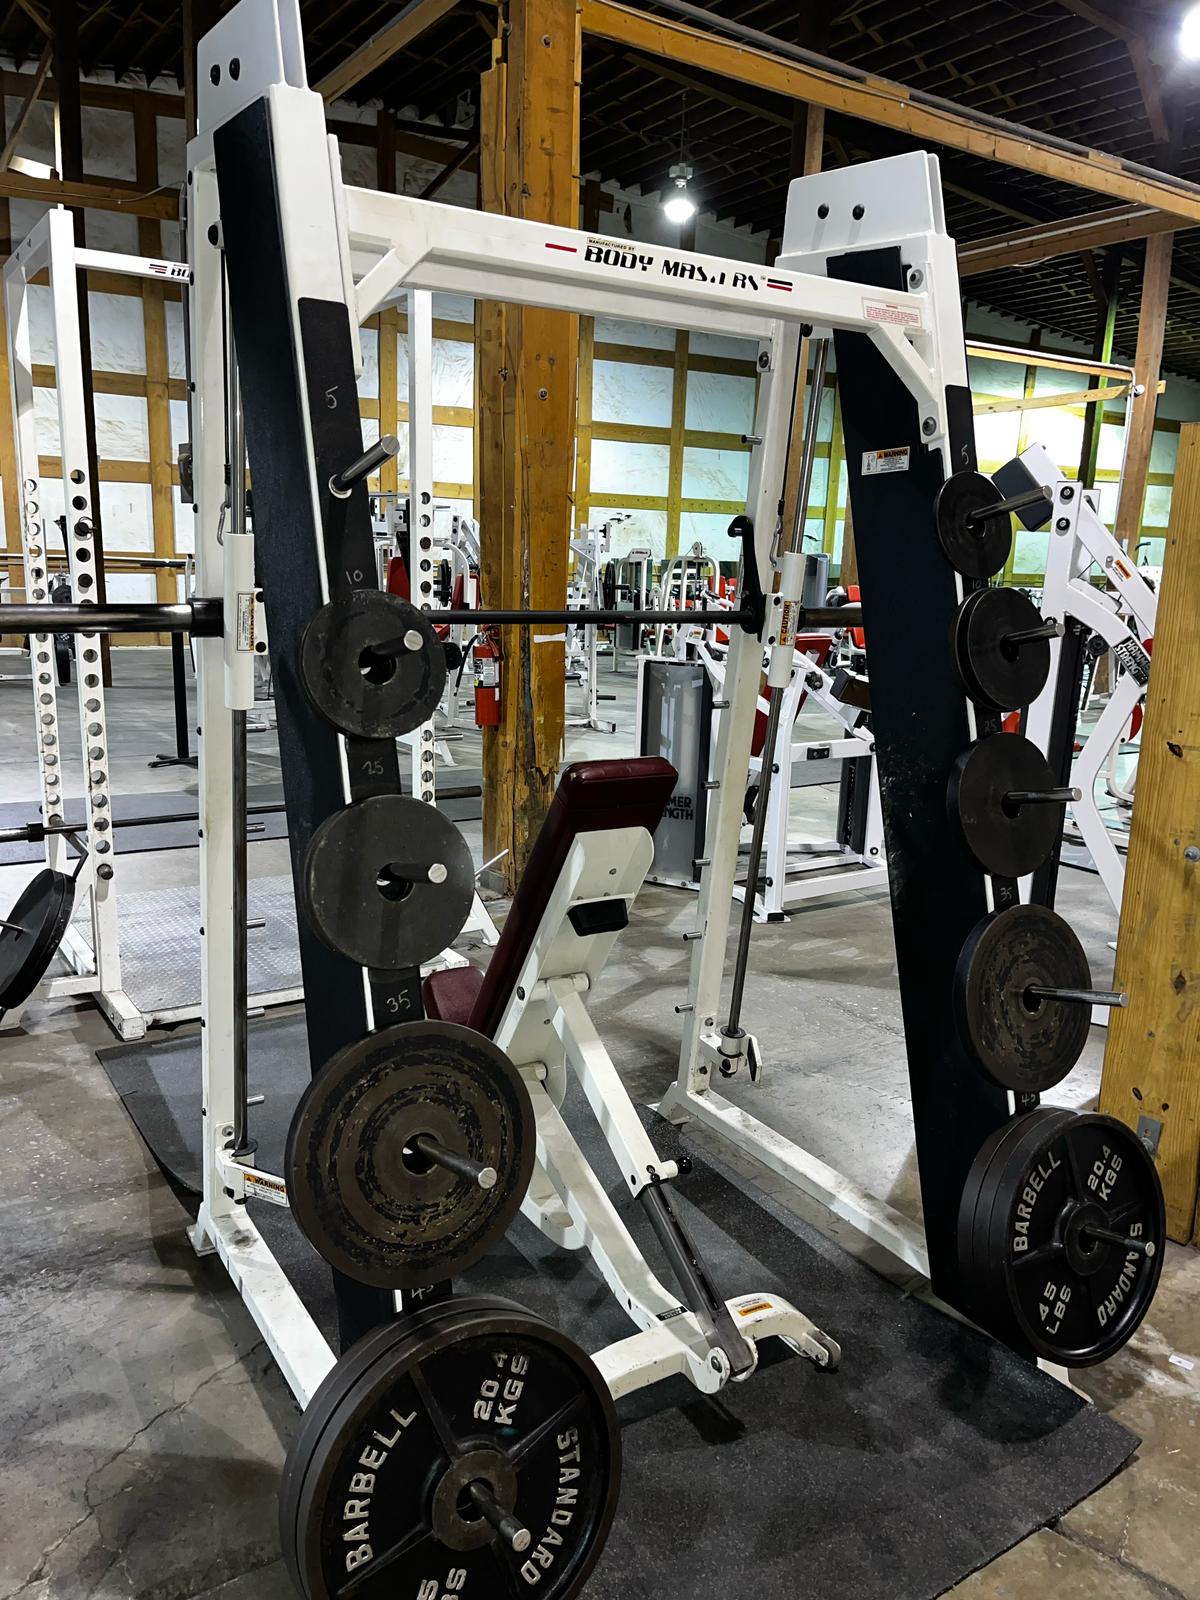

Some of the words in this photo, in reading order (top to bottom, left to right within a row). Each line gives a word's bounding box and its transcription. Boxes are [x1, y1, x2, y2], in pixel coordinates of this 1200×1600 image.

[584, 245, 654, 271] BODY
[588, 239, 627, 250] MANUFACTURED
[325, 385, 338, 409] 5
[884, 448, 908, 458] WARNING
[961, 444, 969, 465] 5
[345, 569, 363, 585] 10
[972, 579, 982, 590] 10
[781, 604, 790, 633] CAUTION
[1124, 639, 1151, 672] HAMME
[386, 989, 411, 1012] 35
[1087, 1144, 1111, 1191] 20.4
[1099, 1154, 1123, 1201] KGS
[255, 1177, 285, 1192] WARNING
[1013, 1151, 1061, 1252] BARBELL
[1097, 1222, 1143, 1327] SANDARD
[1039, 1281, 1057, 1322] 45
[1046, 1285, 1071, 1335] LBS
[473, 1351, 508, 1421] 20.4
[494, 1353, 529, 1425] KGS
[342, 1408, 417, 1572] BARBELL
[521, 1426, 581, 1586] STANDARD
